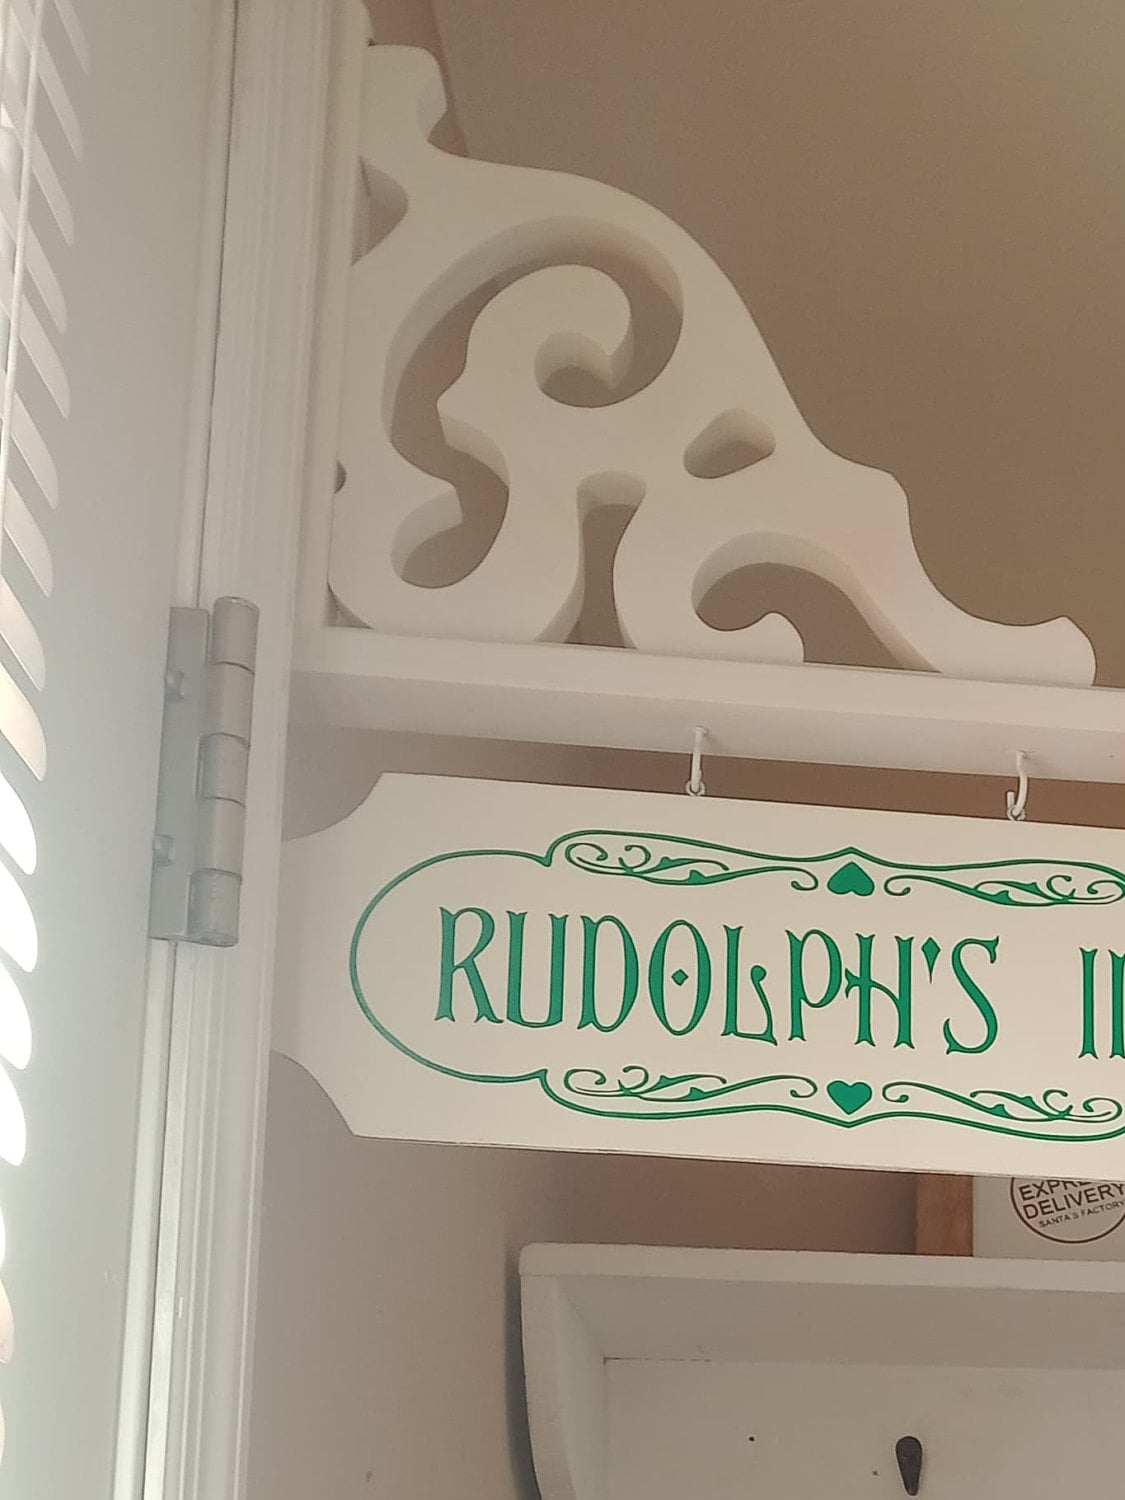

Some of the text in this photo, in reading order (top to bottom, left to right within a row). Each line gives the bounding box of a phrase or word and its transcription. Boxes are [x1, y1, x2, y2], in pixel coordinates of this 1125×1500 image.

[435, 907, 999, 1056] RUDOLPH'S
[1023, 1183, 1123, 1219] DELIVERY
[1081, 1200, 1125, 1216] FACTORY
